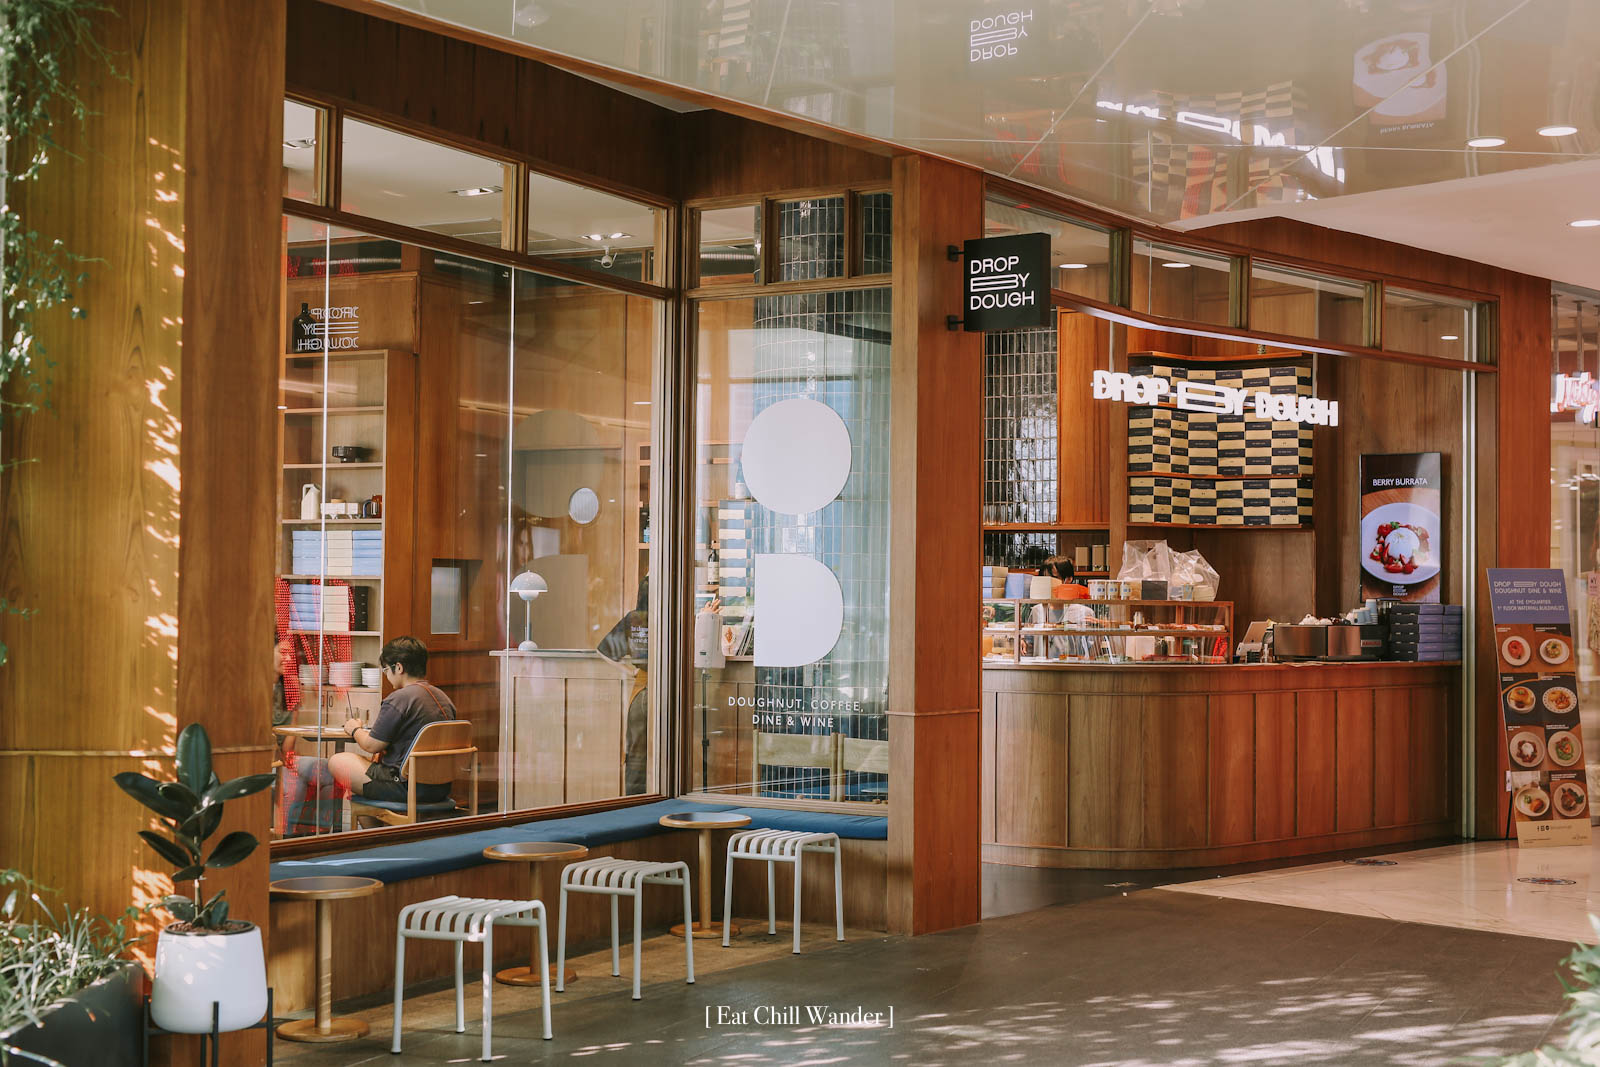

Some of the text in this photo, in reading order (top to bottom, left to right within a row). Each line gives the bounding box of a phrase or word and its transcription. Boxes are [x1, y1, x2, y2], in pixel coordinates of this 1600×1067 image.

[970, 255, 1020, 275] DROP
[970, 272, 1031, 293] BY
[970, 290, 1035, 311] DOUGH
[1093, 370, 1339, 427] DROP BY DOUGH
[1372, 477, 1428, 487] BERRY BURRATA
[728, 696, 864, 713] DOUGHNUT, COFFEE,
[752, 715, 834, 728] DINE & WINE
